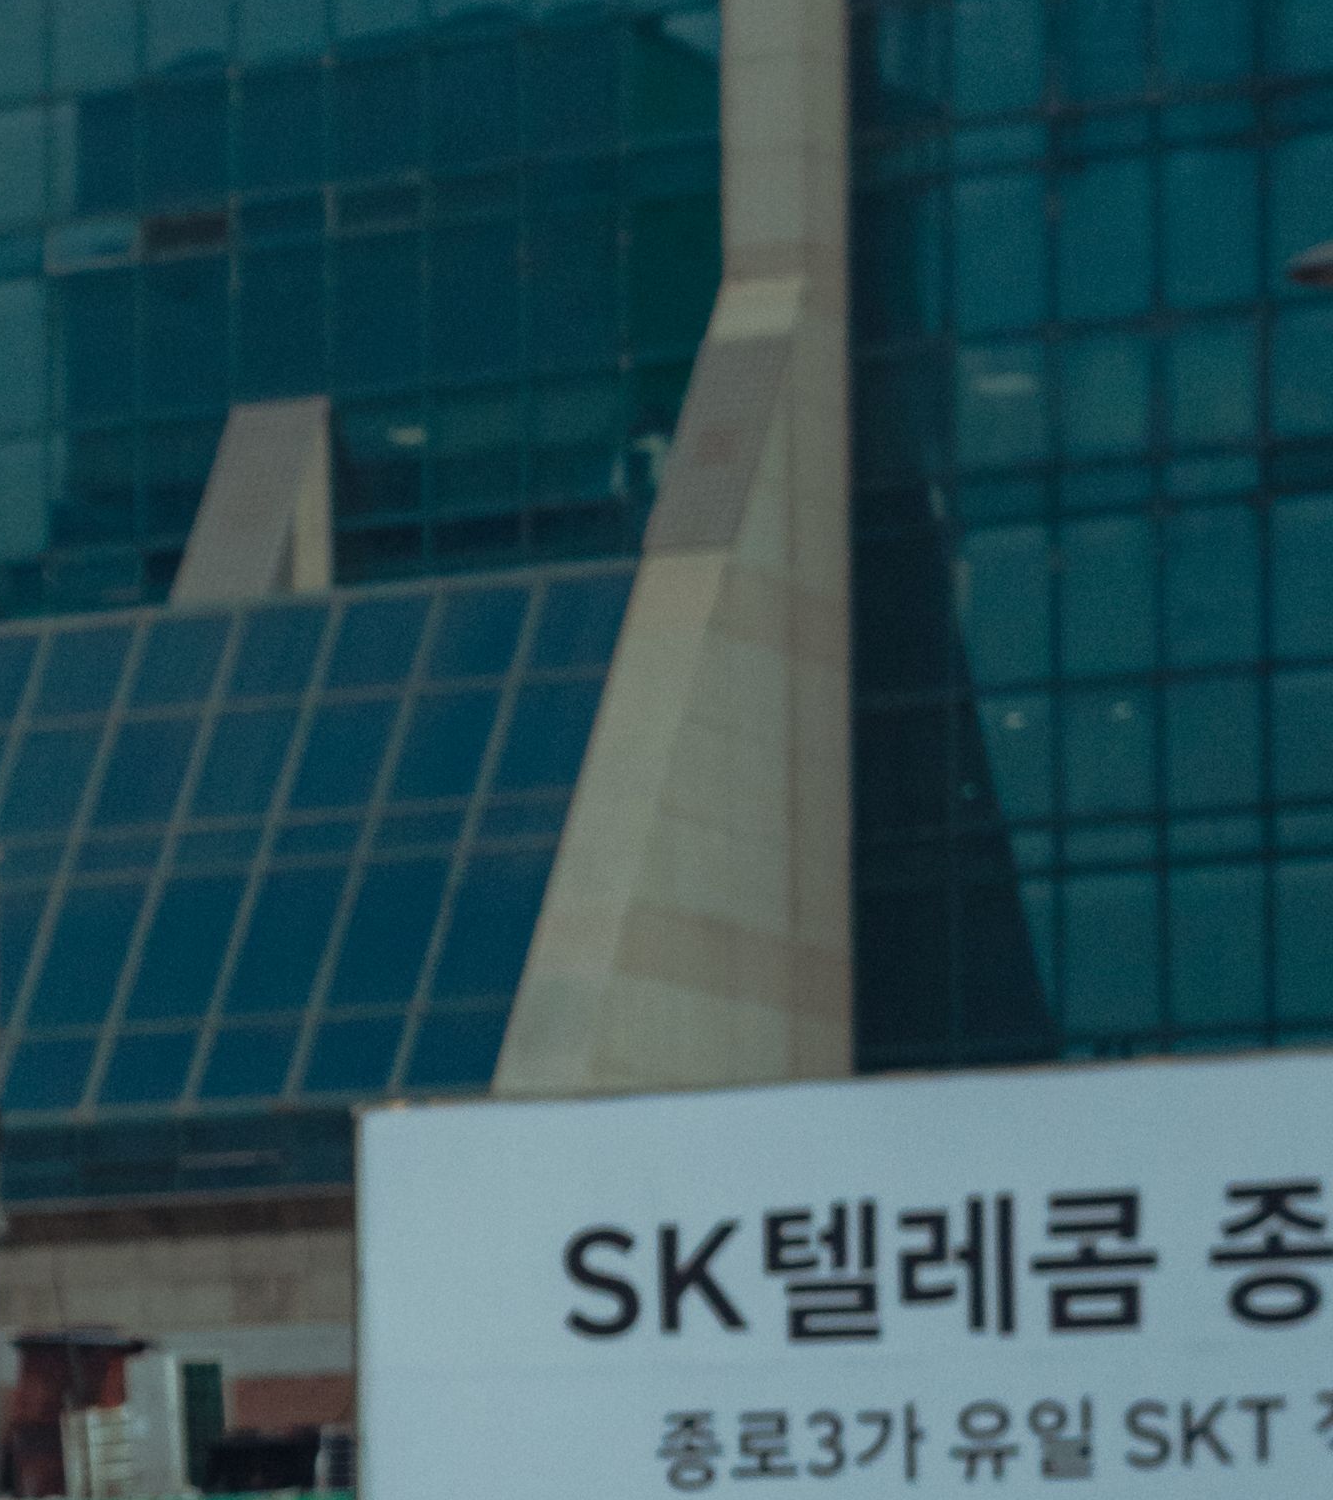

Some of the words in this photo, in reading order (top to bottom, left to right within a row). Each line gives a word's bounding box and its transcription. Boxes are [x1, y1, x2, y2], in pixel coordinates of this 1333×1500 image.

[563, 1185, 1158, 1345] SK텔레콤
[655, 1398, 926, 1493] 종로3가
[947, 1391, 1093, 1482] 유일
[1123, 1392, 1287, 1471] SKT
